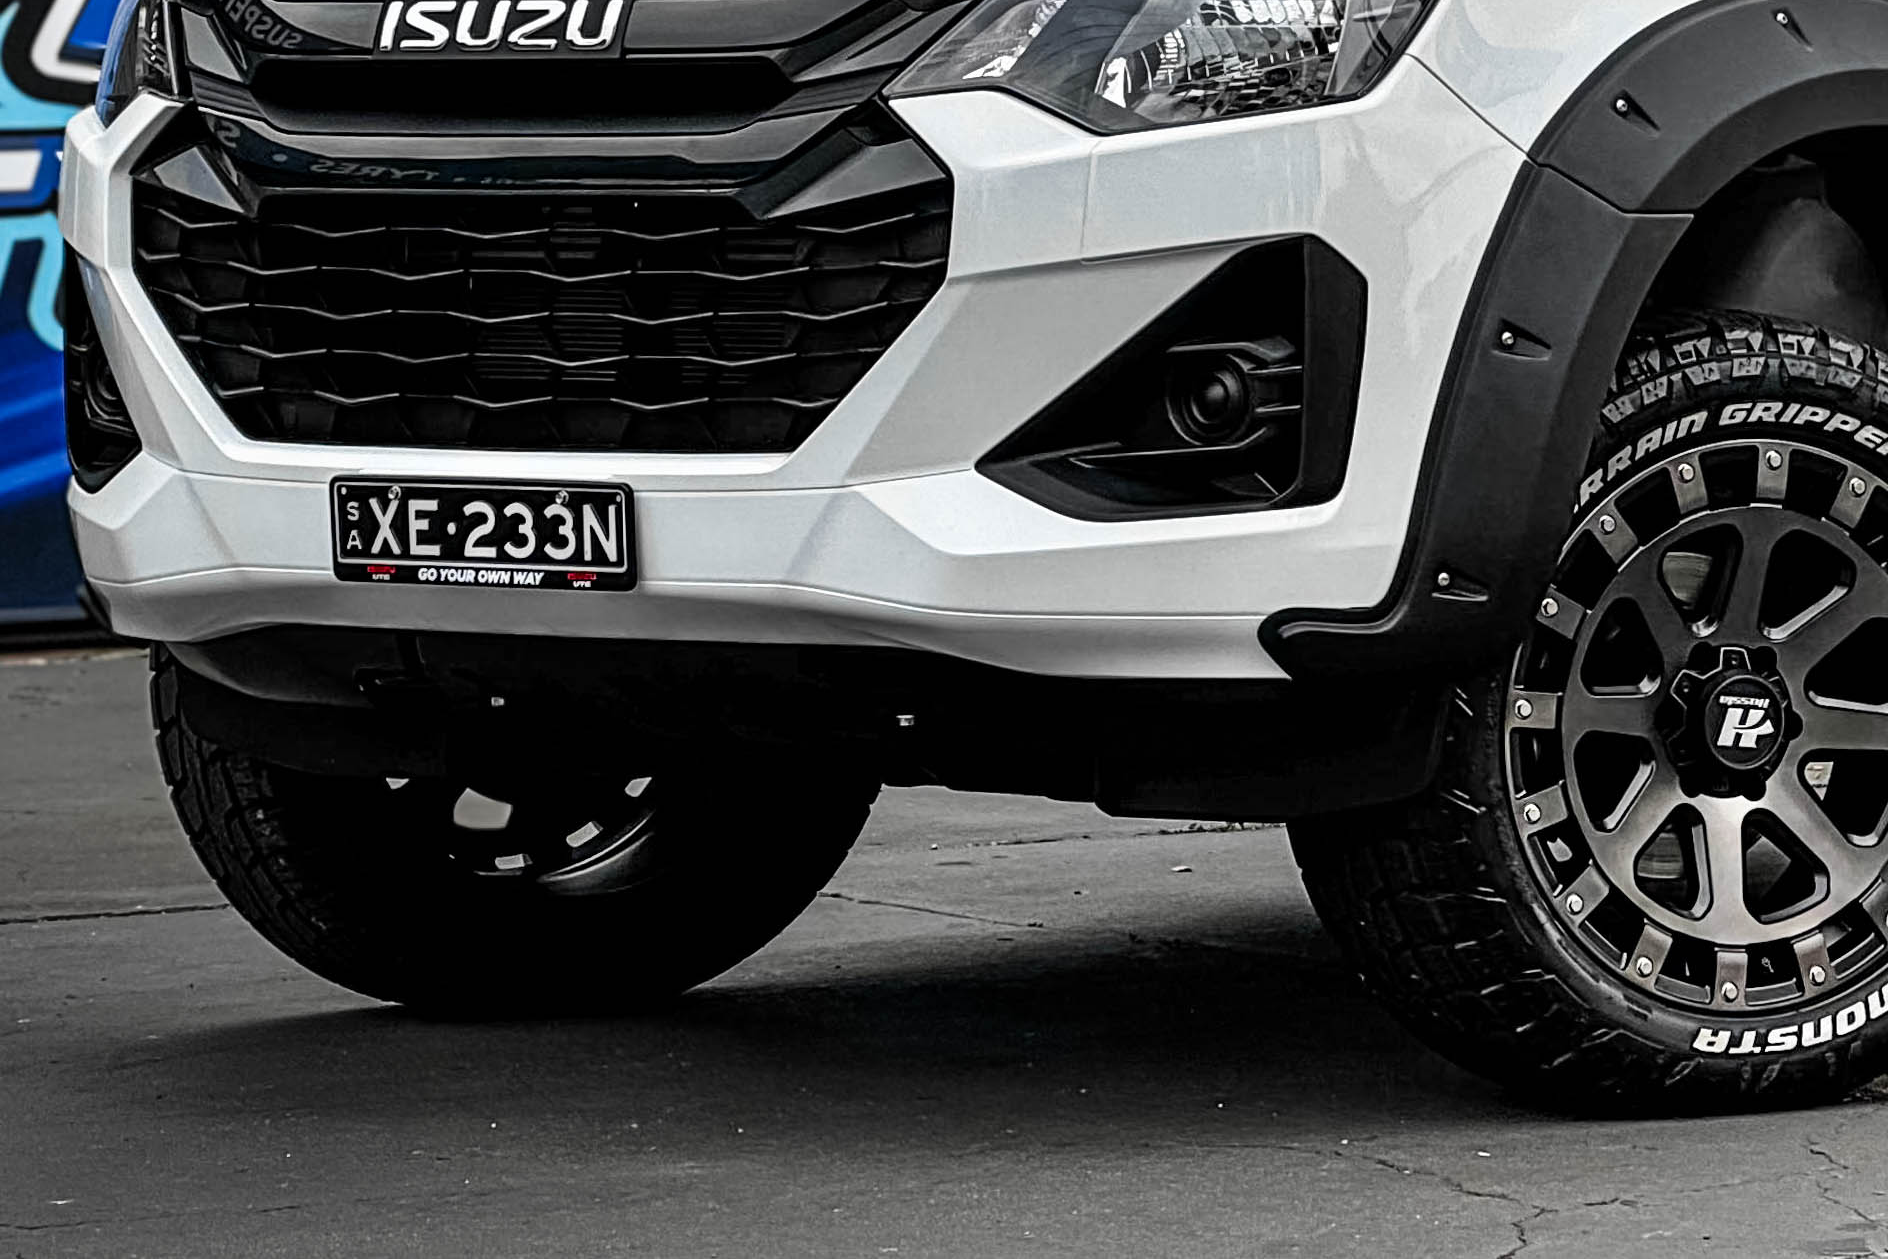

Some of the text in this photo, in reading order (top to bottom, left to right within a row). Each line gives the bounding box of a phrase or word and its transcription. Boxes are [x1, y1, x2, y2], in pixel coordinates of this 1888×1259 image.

[379, 0, 624, 51] ISUZU
[1573, 410, 1708, 514] RRAIN
[418, 568, 544, 586] GO YOUR OWN WAY
